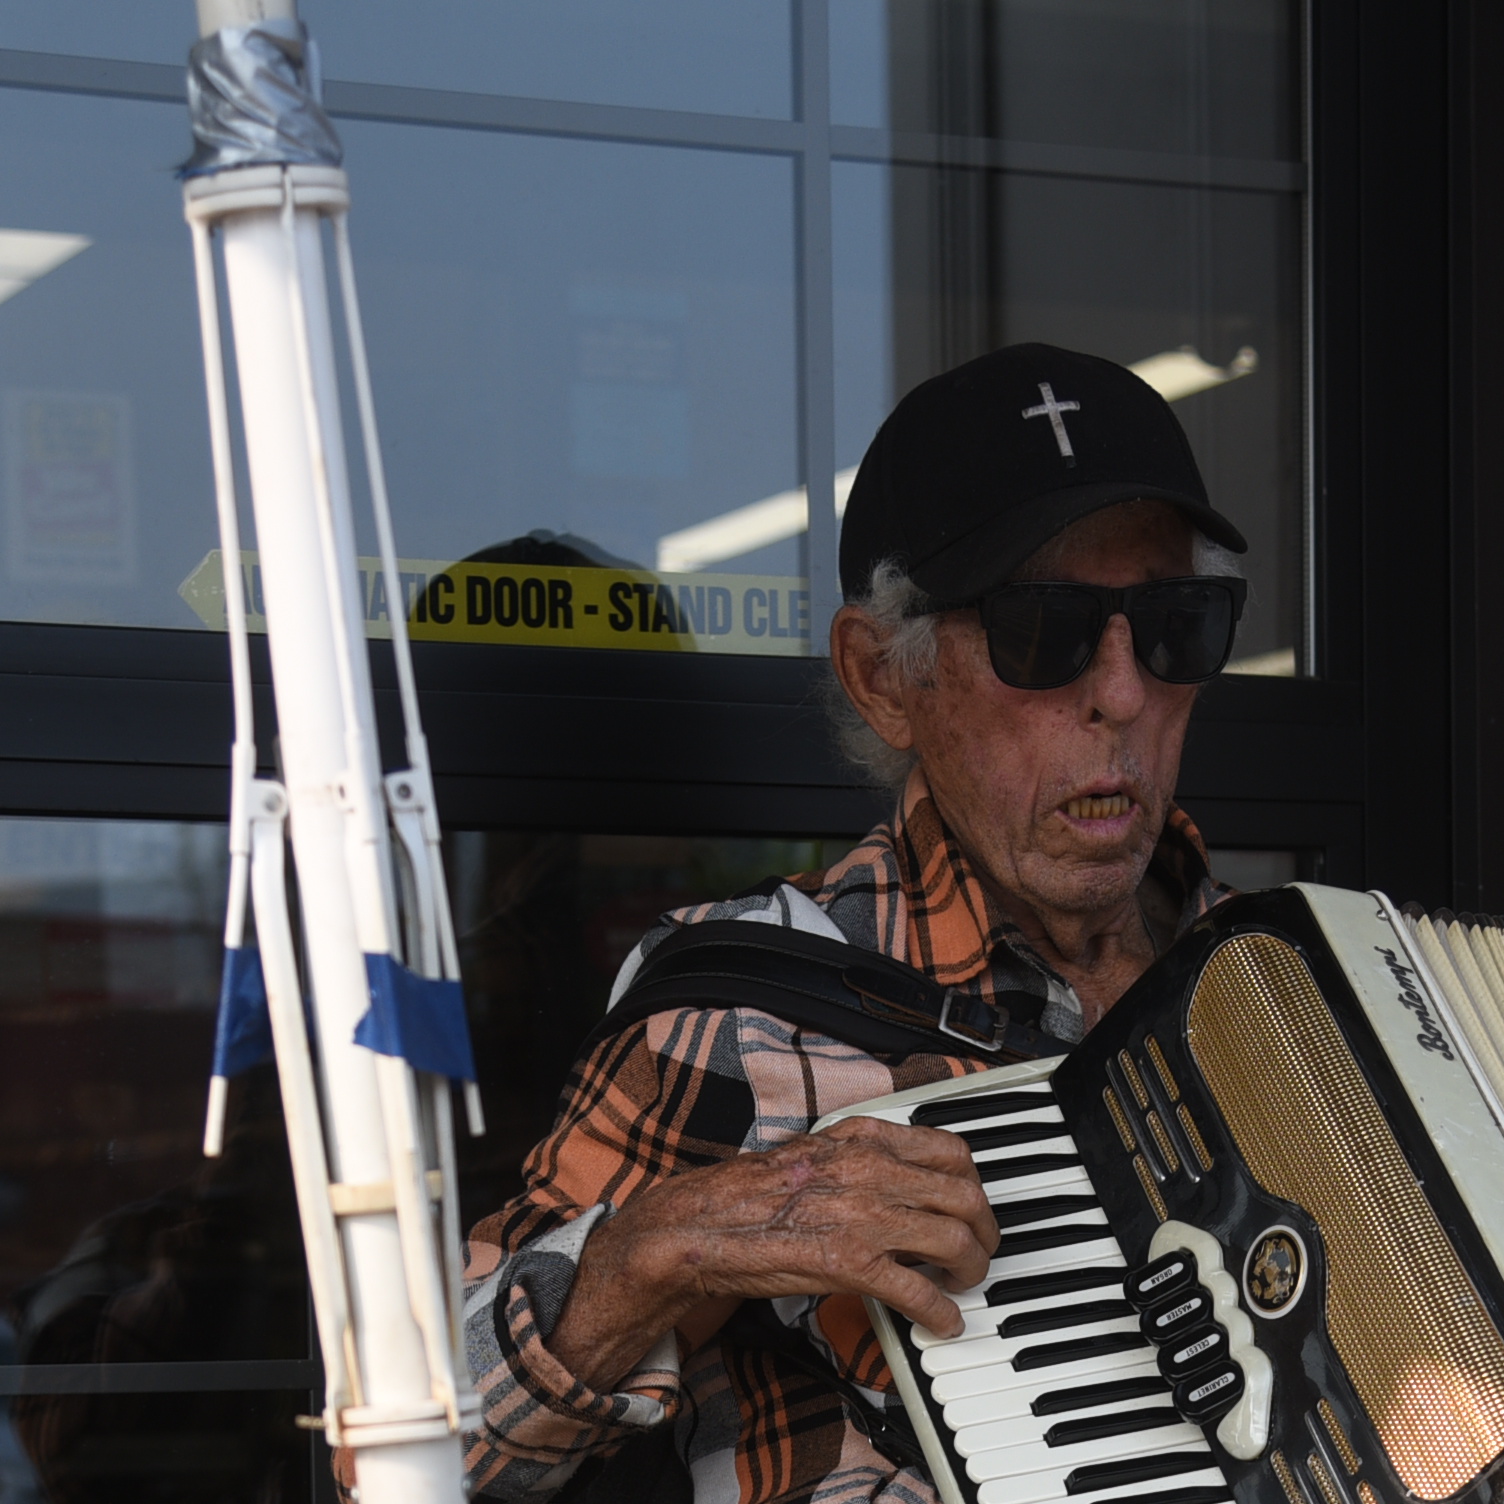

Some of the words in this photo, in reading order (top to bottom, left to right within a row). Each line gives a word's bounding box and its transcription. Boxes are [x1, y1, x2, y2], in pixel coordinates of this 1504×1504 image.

[466, 575, 573, 629] DOOR
[608, 581, 732, 635] STAND
[1151, 1268, 1173, 1285] ORGAN
[1166, 1303, 1192, 1321] MASTER
[1186, 1339, 1210, 1357] CELEST
[1197, 1376, 1229, 1398] CLARINET
